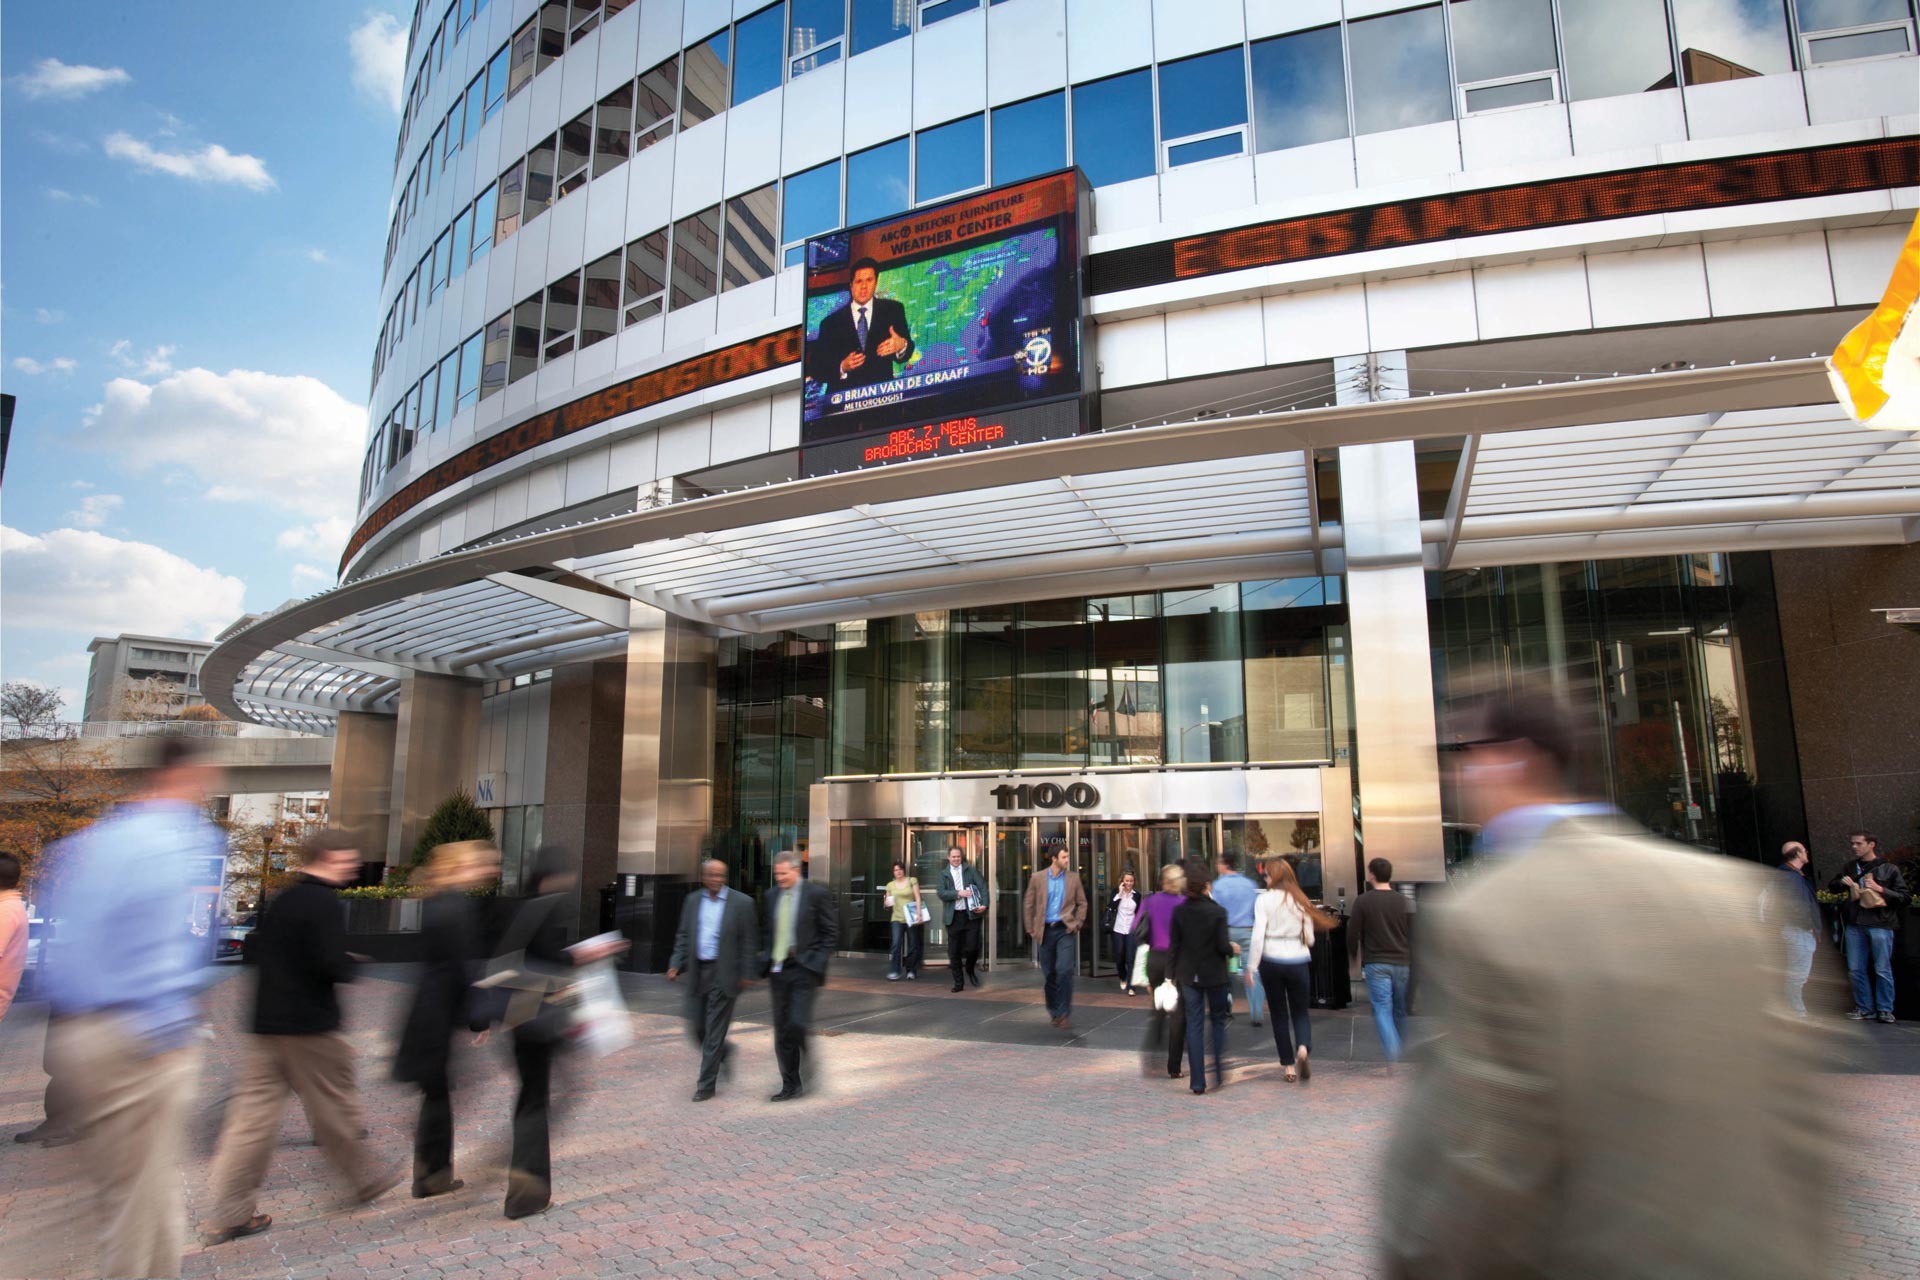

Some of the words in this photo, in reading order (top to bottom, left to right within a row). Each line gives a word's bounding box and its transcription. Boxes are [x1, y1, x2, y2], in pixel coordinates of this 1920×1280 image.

[959, 193, 1024, 221] FURNITURE
[890, 230, 952, 256] WEATHER
[956, 212, 1012, 238] CENTER
[844, 385, 877, 402] BRIAN
[880, 379, 904, 394] VAN
[906, 375, 921, 389] DE
[925, 366, 970, 385] GRAAFF
[1028, 365, 1048, 375] HD
[843, 392, 904, 411] METEOROLOGIST
[864, 436, 942, 462] BROADCAST
[949, 425, 1004, 446] CENTER
[889, 428, 916, 445] ABC
[923, 425, 933, 438] 7
[940, 416, 977, 436] NEWS
[990, 782, 1101, 810] 1100
